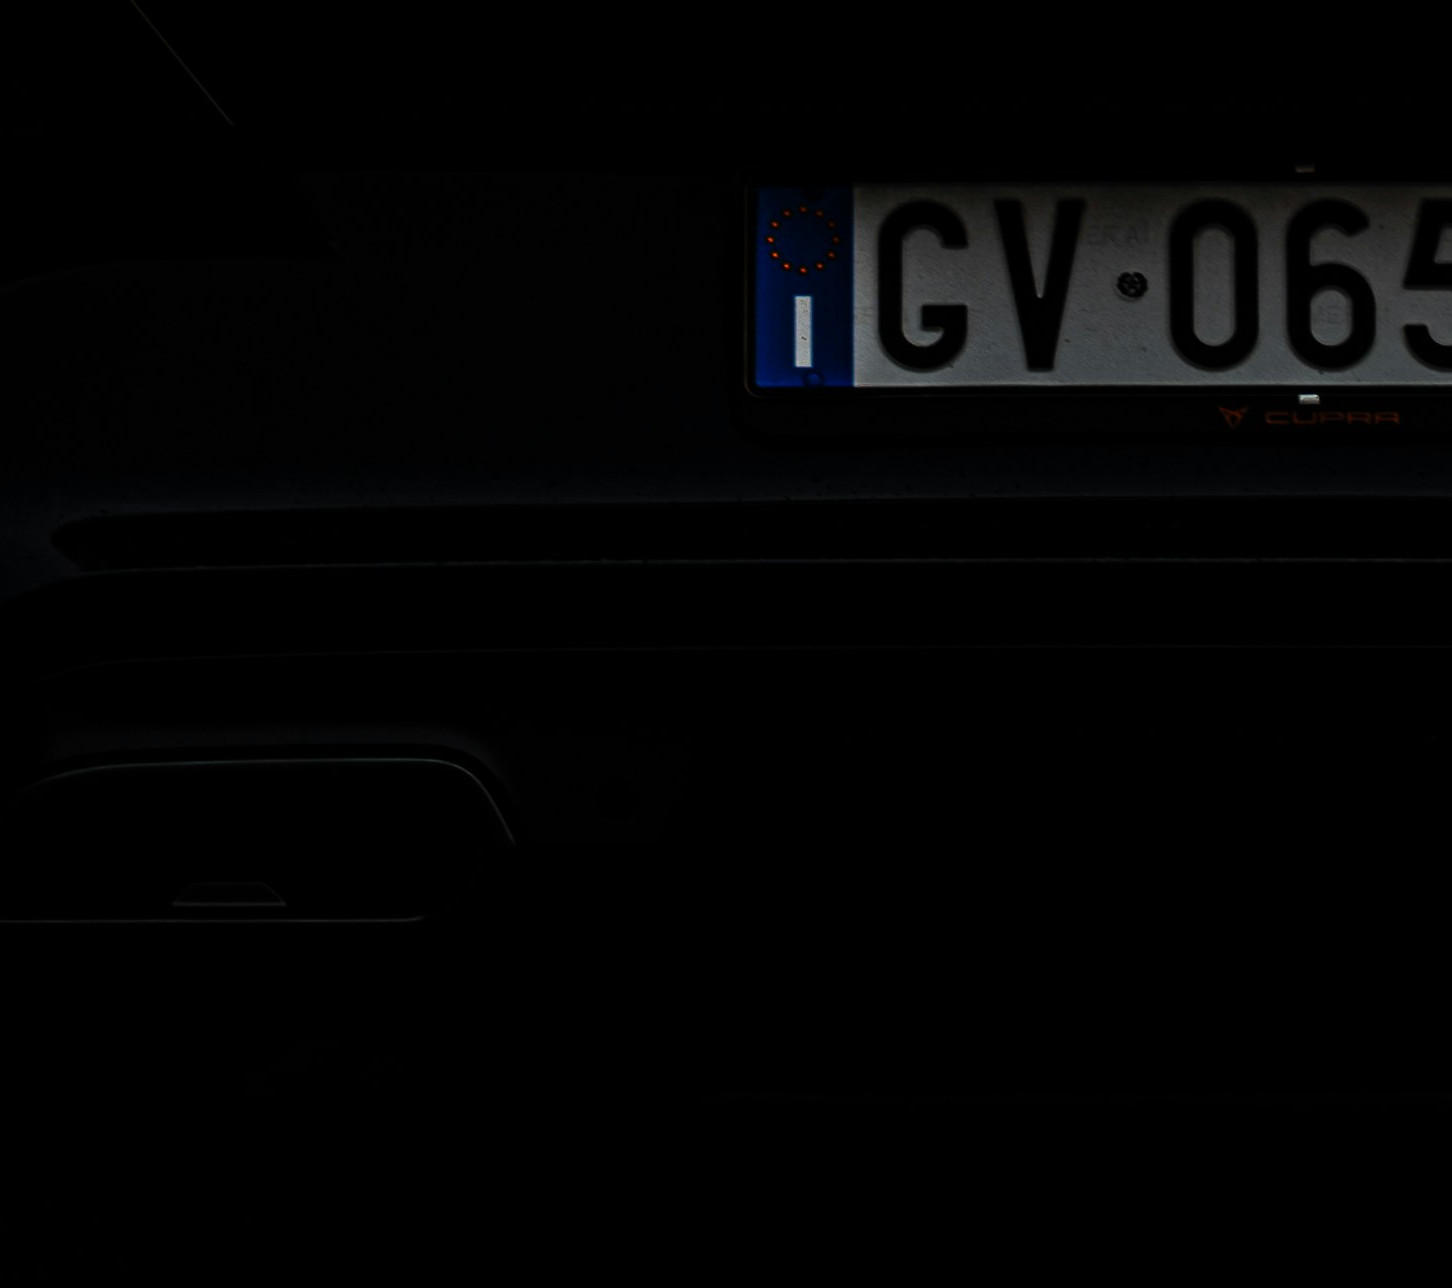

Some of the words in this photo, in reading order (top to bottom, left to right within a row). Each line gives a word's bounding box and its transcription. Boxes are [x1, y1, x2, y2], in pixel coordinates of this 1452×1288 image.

[876, 198, 1085, 371] GV
[793, 294, 814, 369] I
[1263, 409, 1400, 426] CUPRA
